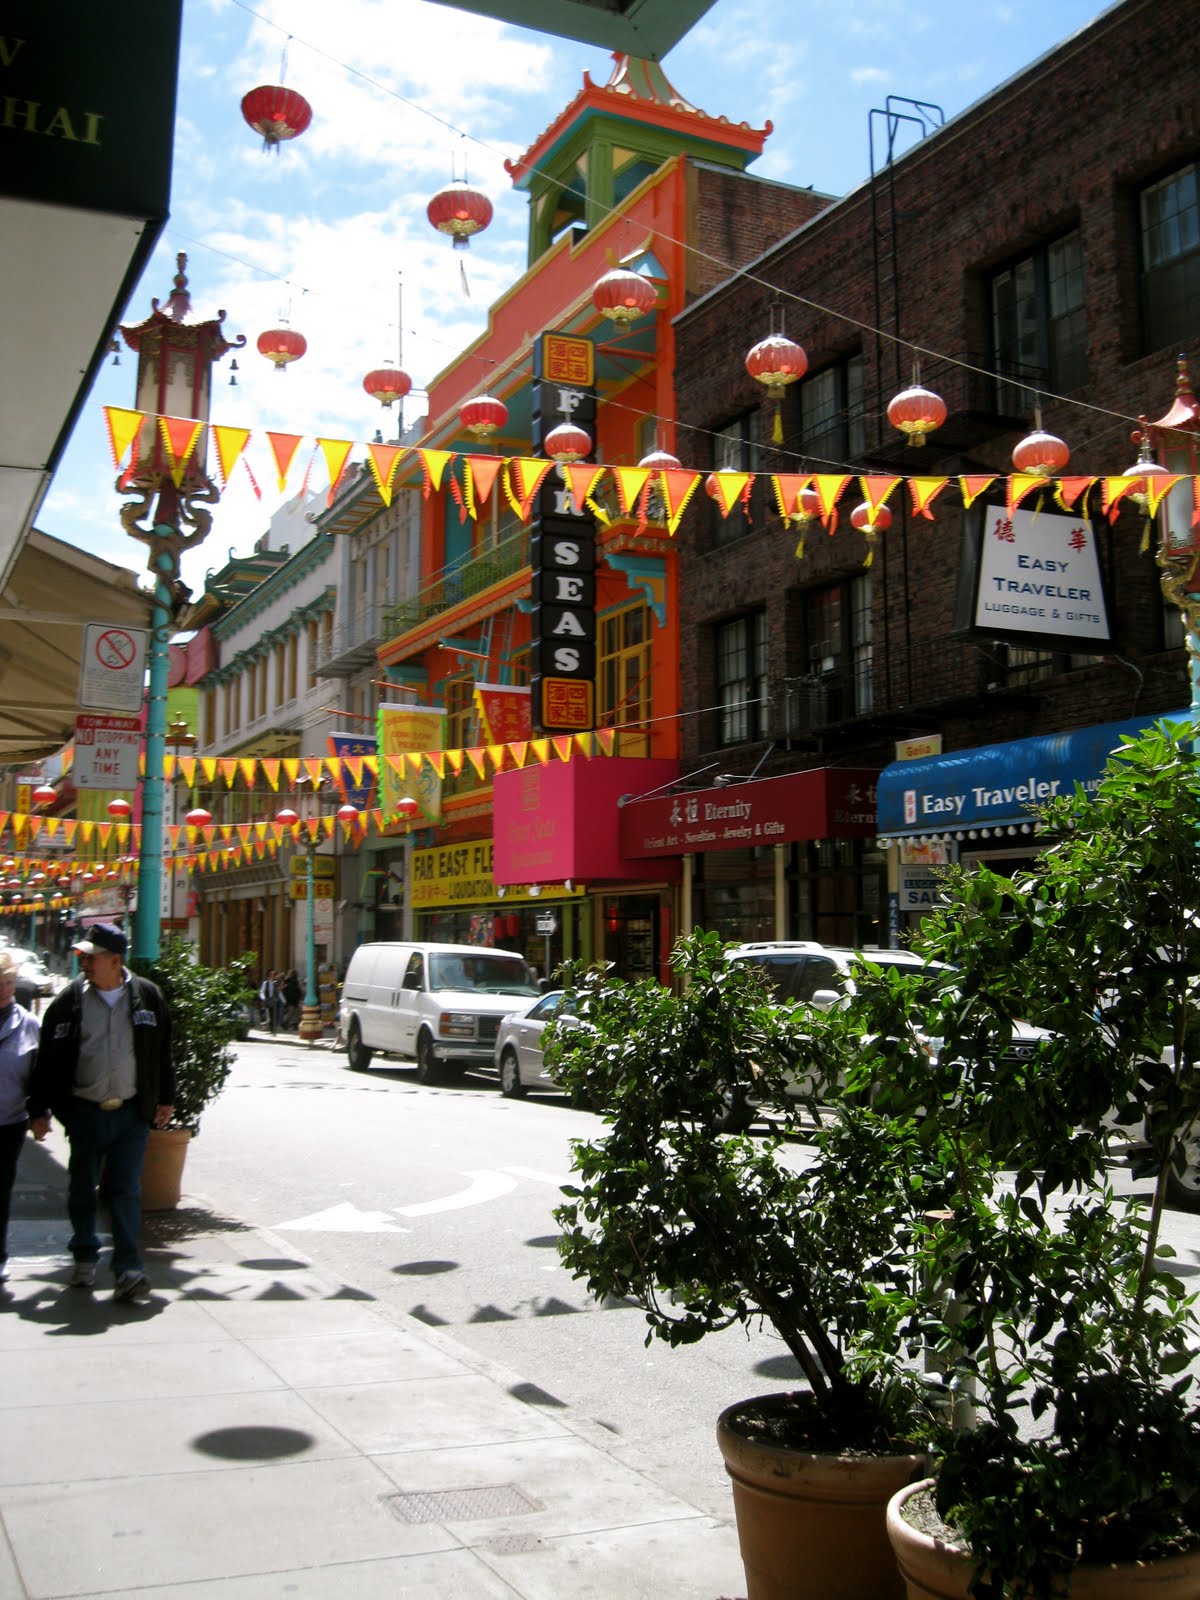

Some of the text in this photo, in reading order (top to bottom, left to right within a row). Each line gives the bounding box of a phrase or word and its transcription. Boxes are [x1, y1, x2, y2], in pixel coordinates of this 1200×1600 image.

[0, 96, 104, 146] HAI
[1018, 555, 1069, 573] EASY
[993, 577, 1091, 601] TRAVELER
[552, 541, 586, 672] SEAS
[985, 602, 1101, 623] LUGGAGE & GIFTS
[81, 717, 136, 729] TOW-AWAY
[77, 729, 139, 744] NO STOPPING
[96, 748, 120, 759] ANY
[93, 762, 120, 775] TIME
[922, 794, 966, 815] Easy
[972, 777, 1060, 807] Traveler
[705, 799, 752, 820] Eternity
[723, 826, 752, 839] Jewelry
[764, 821, 785, 835] Gifts
[414, 854, 434, 881] FAR
[439, 848, 469, 878] EAST
[449, 879, 493, 900] LIQUIDATION
